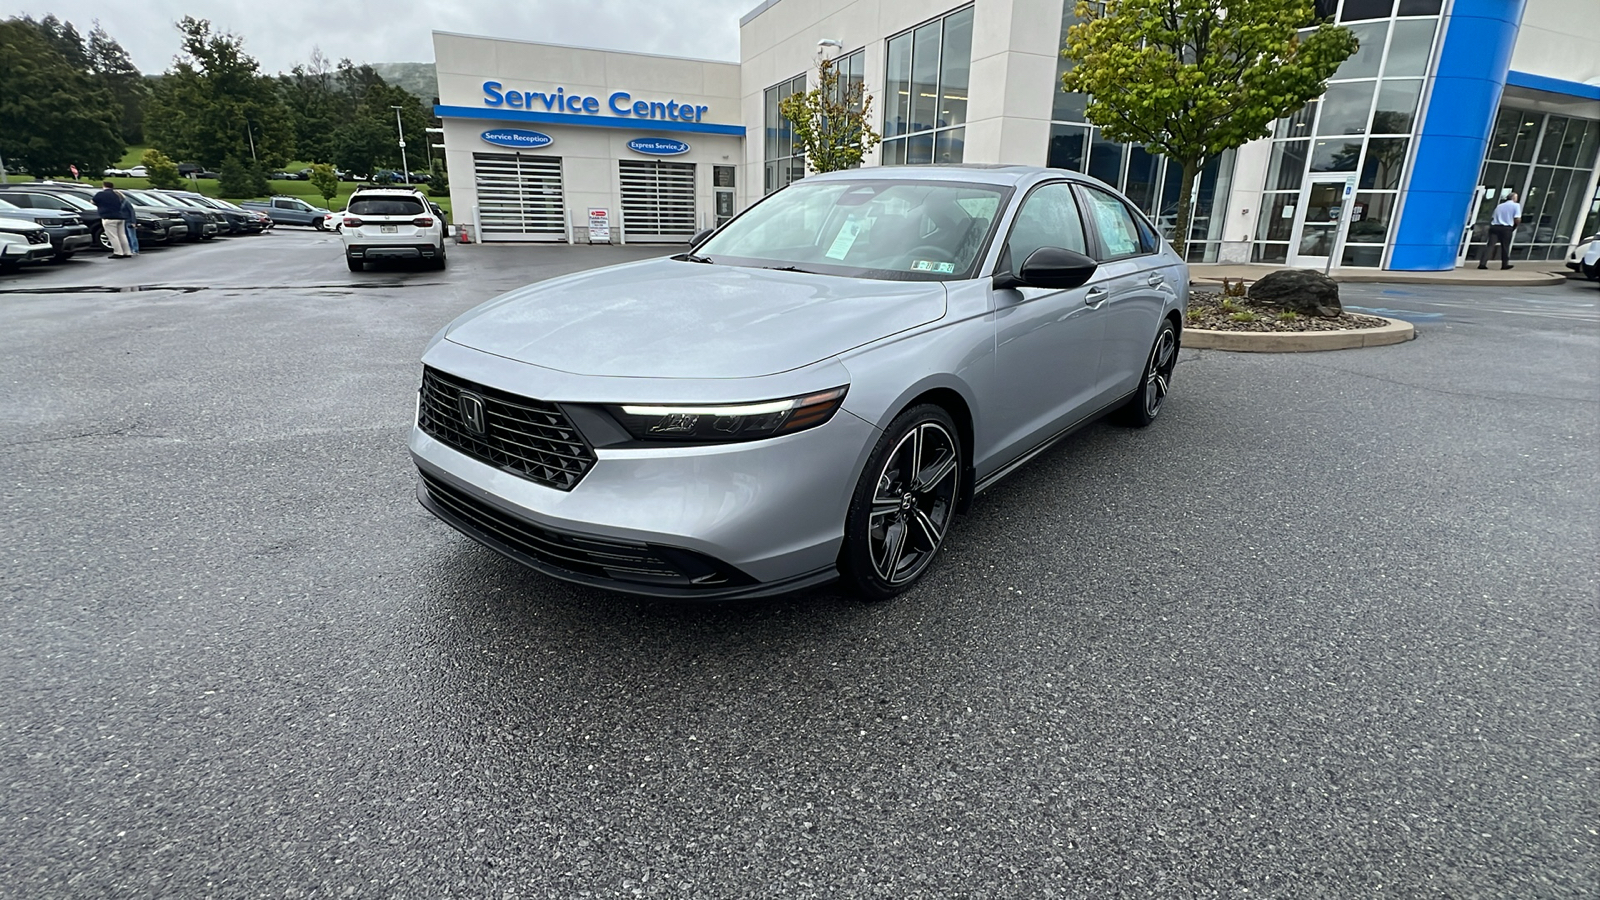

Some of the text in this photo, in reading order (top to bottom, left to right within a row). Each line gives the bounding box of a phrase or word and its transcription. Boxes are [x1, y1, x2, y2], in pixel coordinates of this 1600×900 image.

[482, 81, 708, 122] Service Center
[485, 132, 549, 143] Service Reception
[631, 141, 678, 150] Express Service
